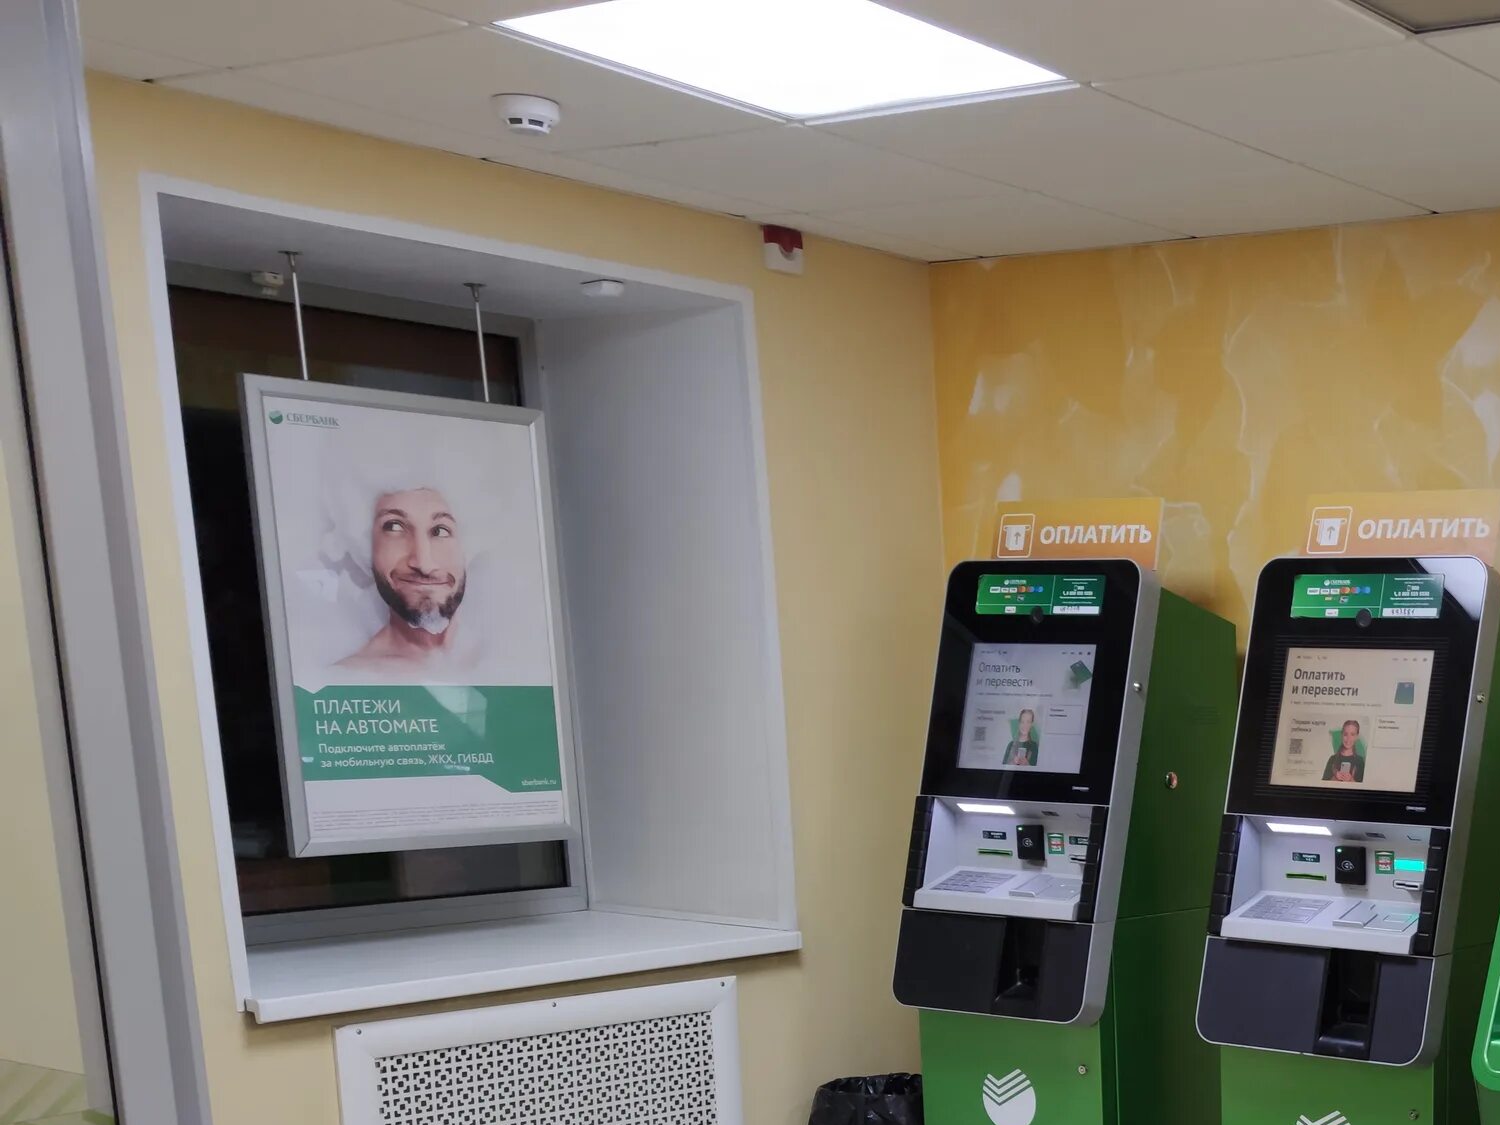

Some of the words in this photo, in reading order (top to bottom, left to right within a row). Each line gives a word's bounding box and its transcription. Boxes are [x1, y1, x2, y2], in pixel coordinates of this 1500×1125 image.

[286, 412, 341, 427] СБЕРБАНК
[1039, 524, 1152, 545] ОПЛАТИТЬ
[1357, 517, 1491, 540] ОПЛАТИТЬ
[978, 662, 1021, 673] Оплатить
[1294, 668, 1346, 681] Оплатить
[985, 679, 1033, 688] перевести
[1291, 686, 1299, 695] и
[1302, 686, 1358, 697] перевести
[313, 699, 401, 715] ПЛАТЕЖИ
[315, 720, 342, 735] НА
[346, 718, 439, 735] АВТОМАТЕ
[319, 743, 385, 755] Подключите
[320, 759, 332, 768] за
[335, 757, 395, 768] мобильную
[397, 757, 427, 767] связь,
[428, 753, 456, 766] ЖКХ,
[458, 752, 495, 765] ГИБДД
